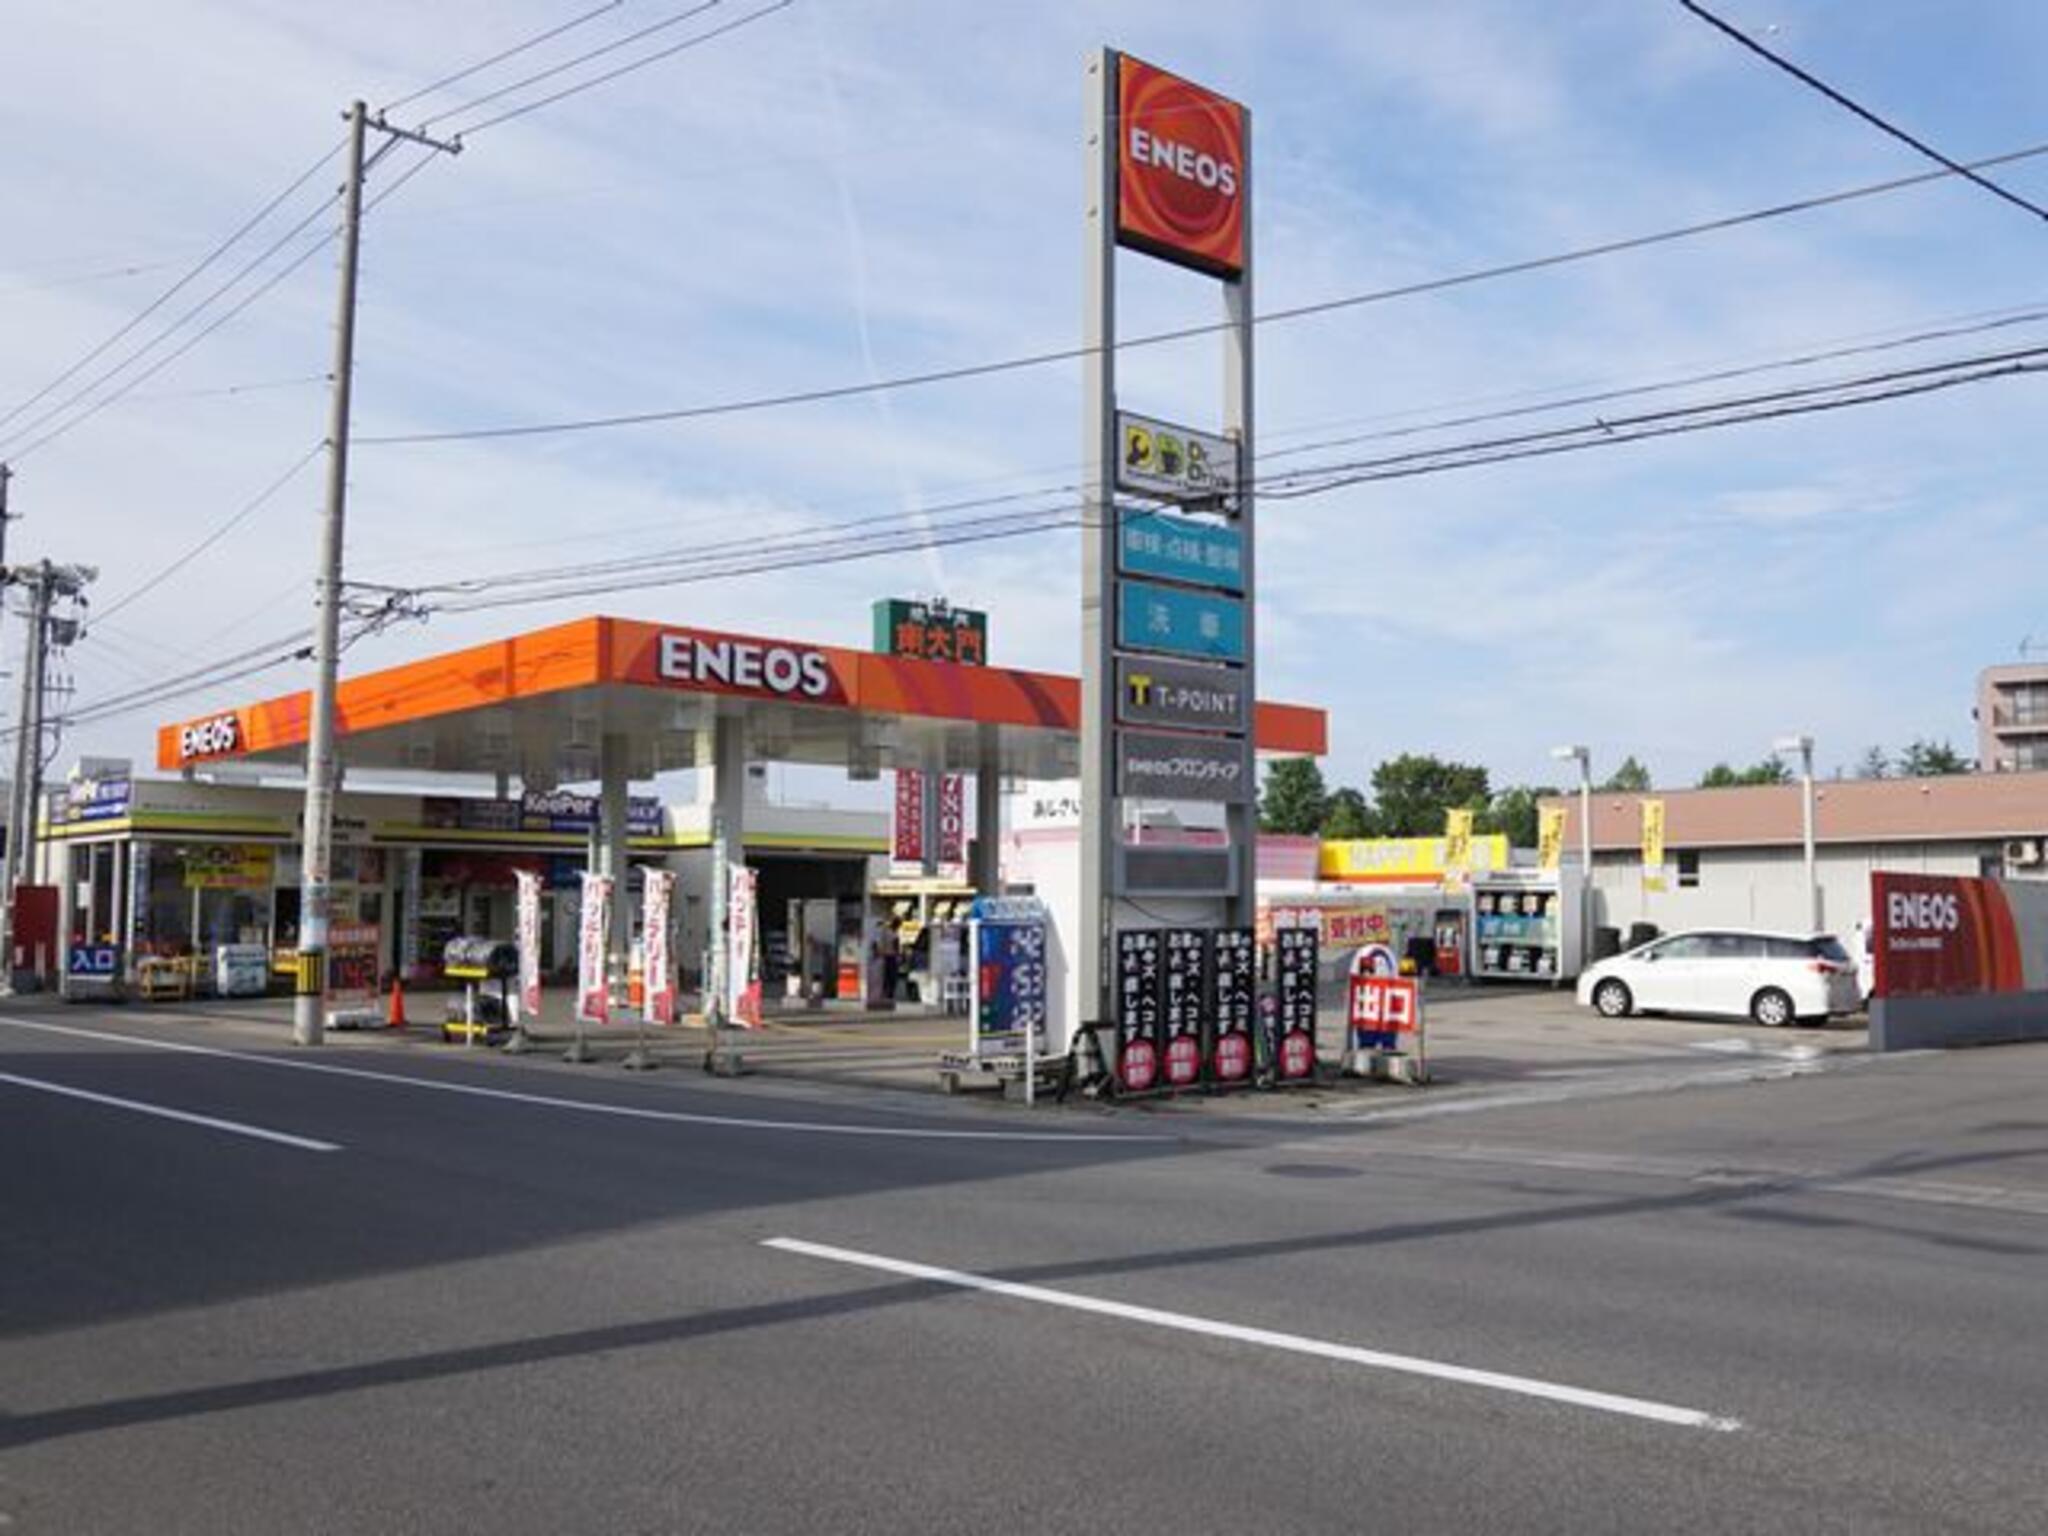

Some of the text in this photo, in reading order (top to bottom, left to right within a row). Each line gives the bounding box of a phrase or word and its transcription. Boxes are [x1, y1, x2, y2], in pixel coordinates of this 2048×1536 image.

[1130, 126, 1237, 196] ENEOS
[659, 635, 829, 697] ENEOS
[1157, 686, 1237, 714] T-POINT
[181, 715, 236, 759] ENEOS
[1888, 891, 1959, 931] ENEOS
[71, 949, 114, 971] 入口
[1352, 984, 1410, 1024] 出口
